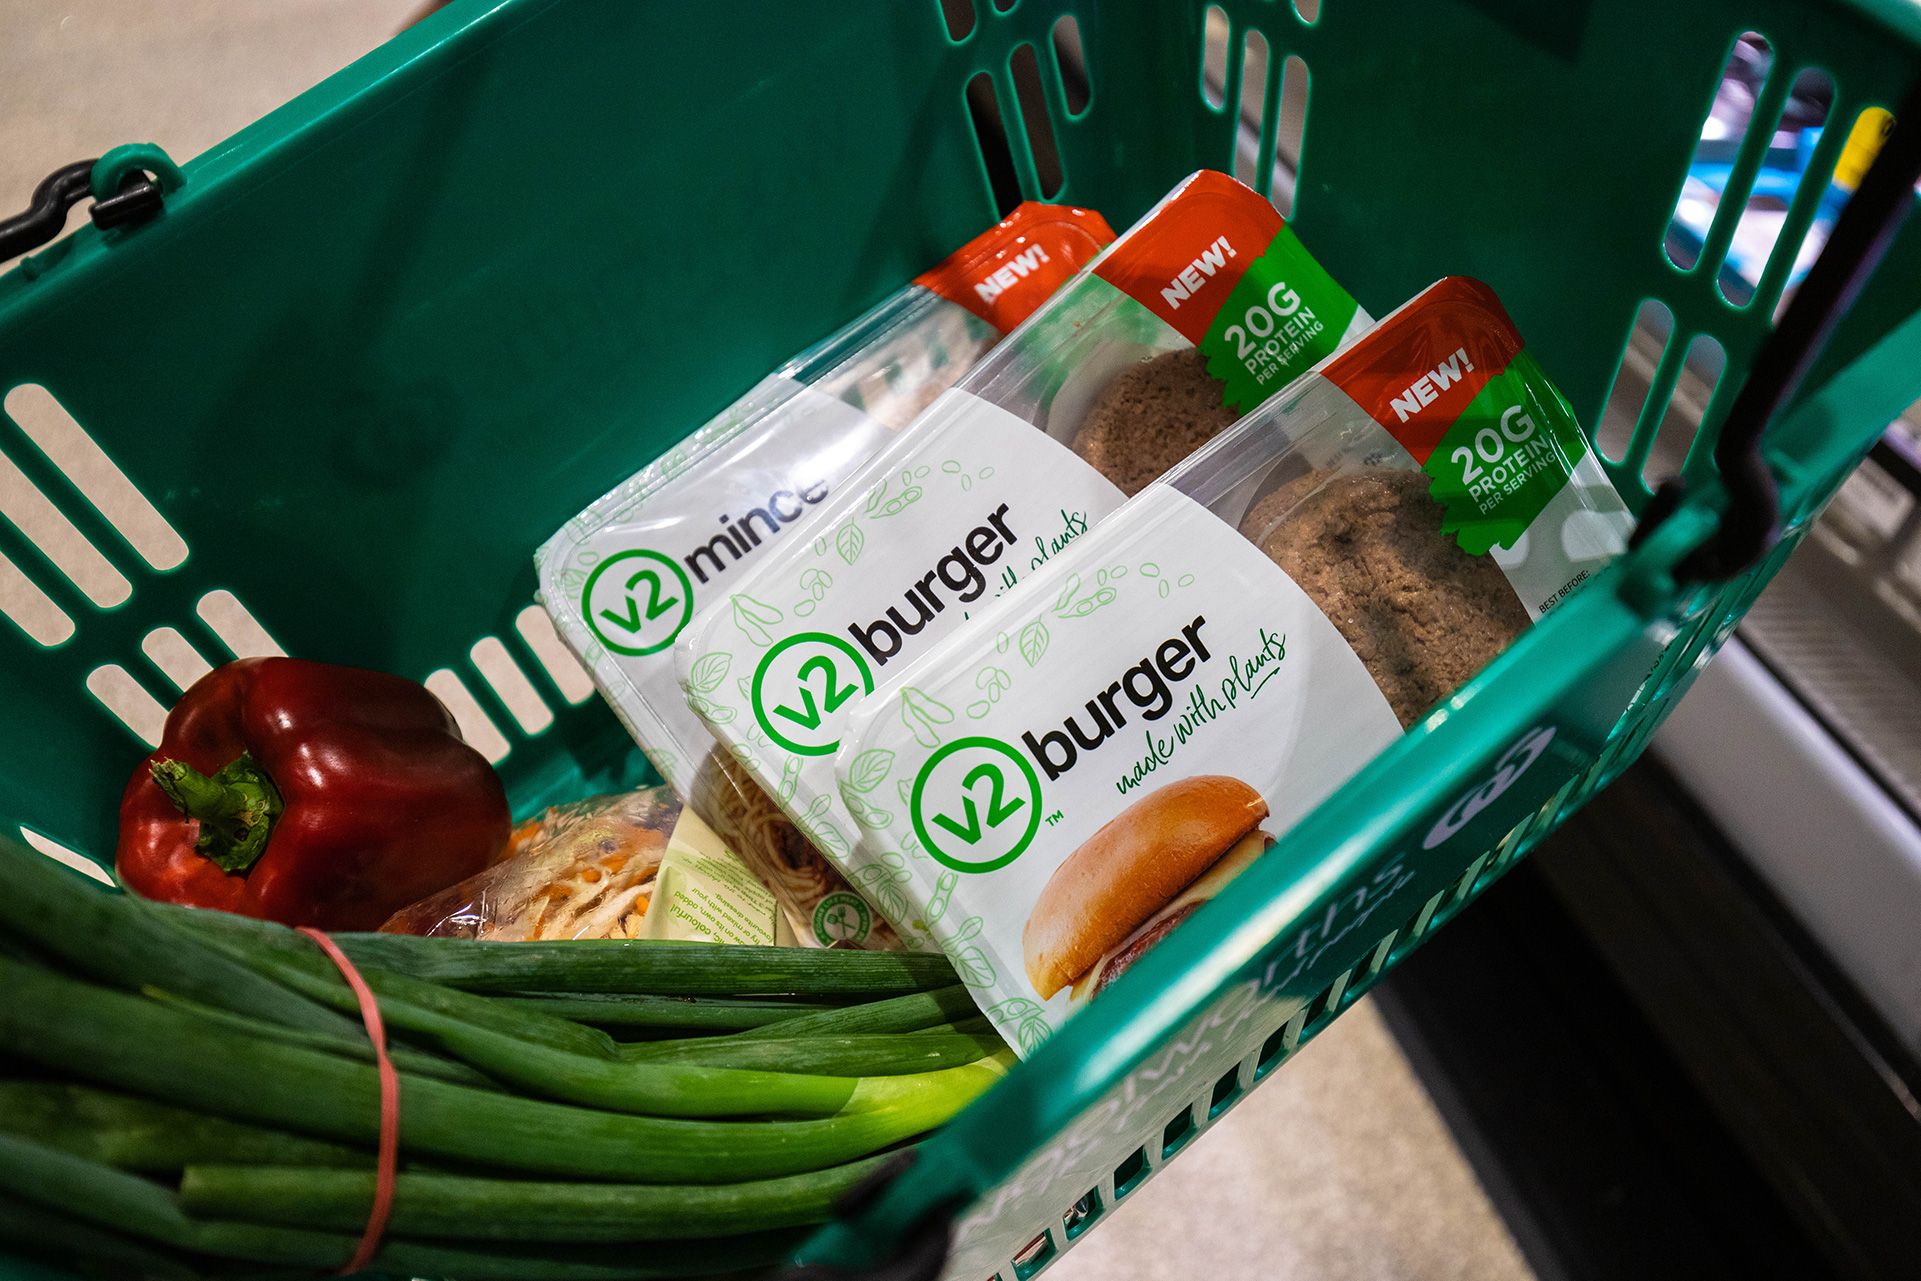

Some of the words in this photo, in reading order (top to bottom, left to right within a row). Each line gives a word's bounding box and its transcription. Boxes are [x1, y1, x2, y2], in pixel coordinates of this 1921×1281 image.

[974, 244, 1047, 304] NEW!
[1160, 235, 1237, 310] NEW!
[1224, 282, 1301, 360] 20G
[1244, 306, 1316, 375] PROTEIN
[1256, 363, 1279, 385] PER
[1277, 320, 1324, 366] SERVING
[1390, 347, 1475, 423] NEW!
[1451, 405, 1535, 485] 20G
[1468, 435, 1549, 503] PROTEIN
[1479, 493, 1504, 515] PER
[1503, 451, 1556, 495] SERVING
[599, 569, 679, 634] v2
[684, 479, 829, 584] mince
[772, 655, 859, 731] v2
[847, 503, 1017, 666] burger
[1538, 594, 1559, 614] BEST
[1558, 570, 1590, 599] BEFORE:
[931, 763, 1026, 845] v2
[1021, 614, 1211, 781] burger
[1116, 730, 1174, 795] made
[1174, 684, 1226, 745] with
[1222, 628, 1286, 709] plants
[669, 904, 711, 935] colourful
[673, 890, 699, 909] added
[692, 888, 708, 901] your
[707, 899, 723, 914] with
[714, 893, 744, 919] dressing.
[715, 918, 725, 930] its
[722, 912, 743, 930] mixed
[724, 928, 734, 938] on
[743, 928, 751, 937] or
[744, 916, 773, 943] favourite
